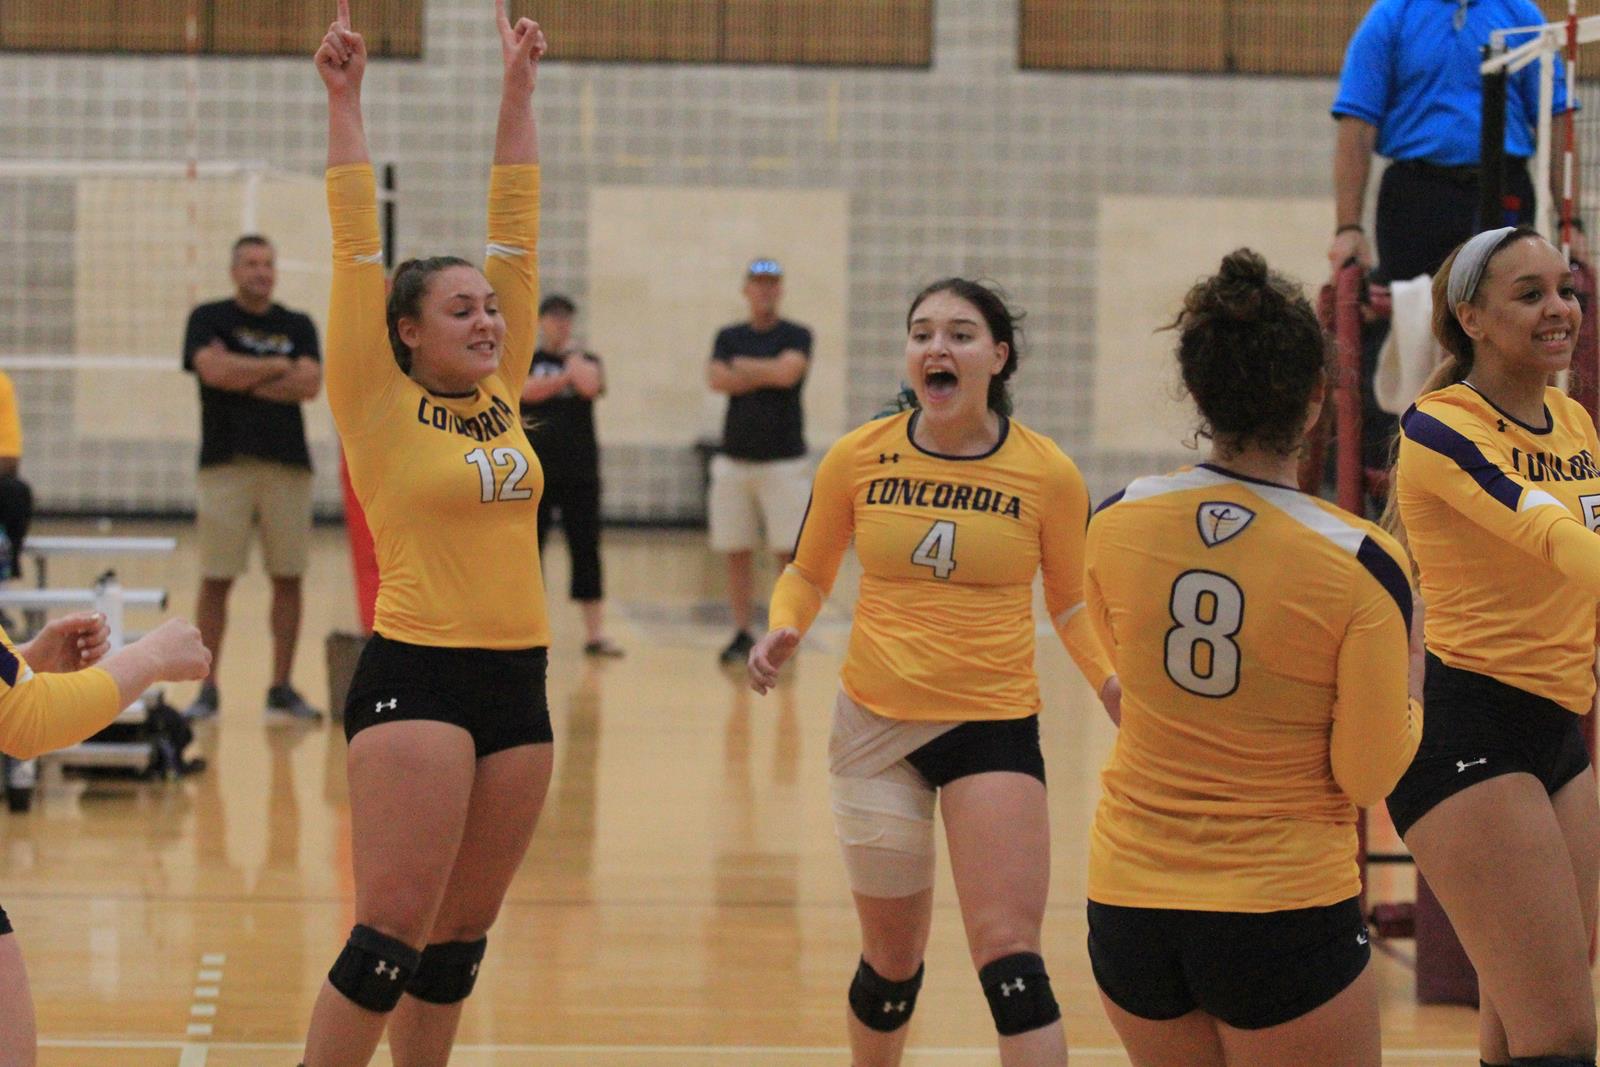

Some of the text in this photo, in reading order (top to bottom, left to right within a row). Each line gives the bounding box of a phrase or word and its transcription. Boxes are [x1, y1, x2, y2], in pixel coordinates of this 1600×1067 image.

[464, 447, 533, 503] 12
[866, 477, 1021, 519] CONCORDIA
[911, 519, 957, 579] 4
[1164, 569, 1245, 699] 8
